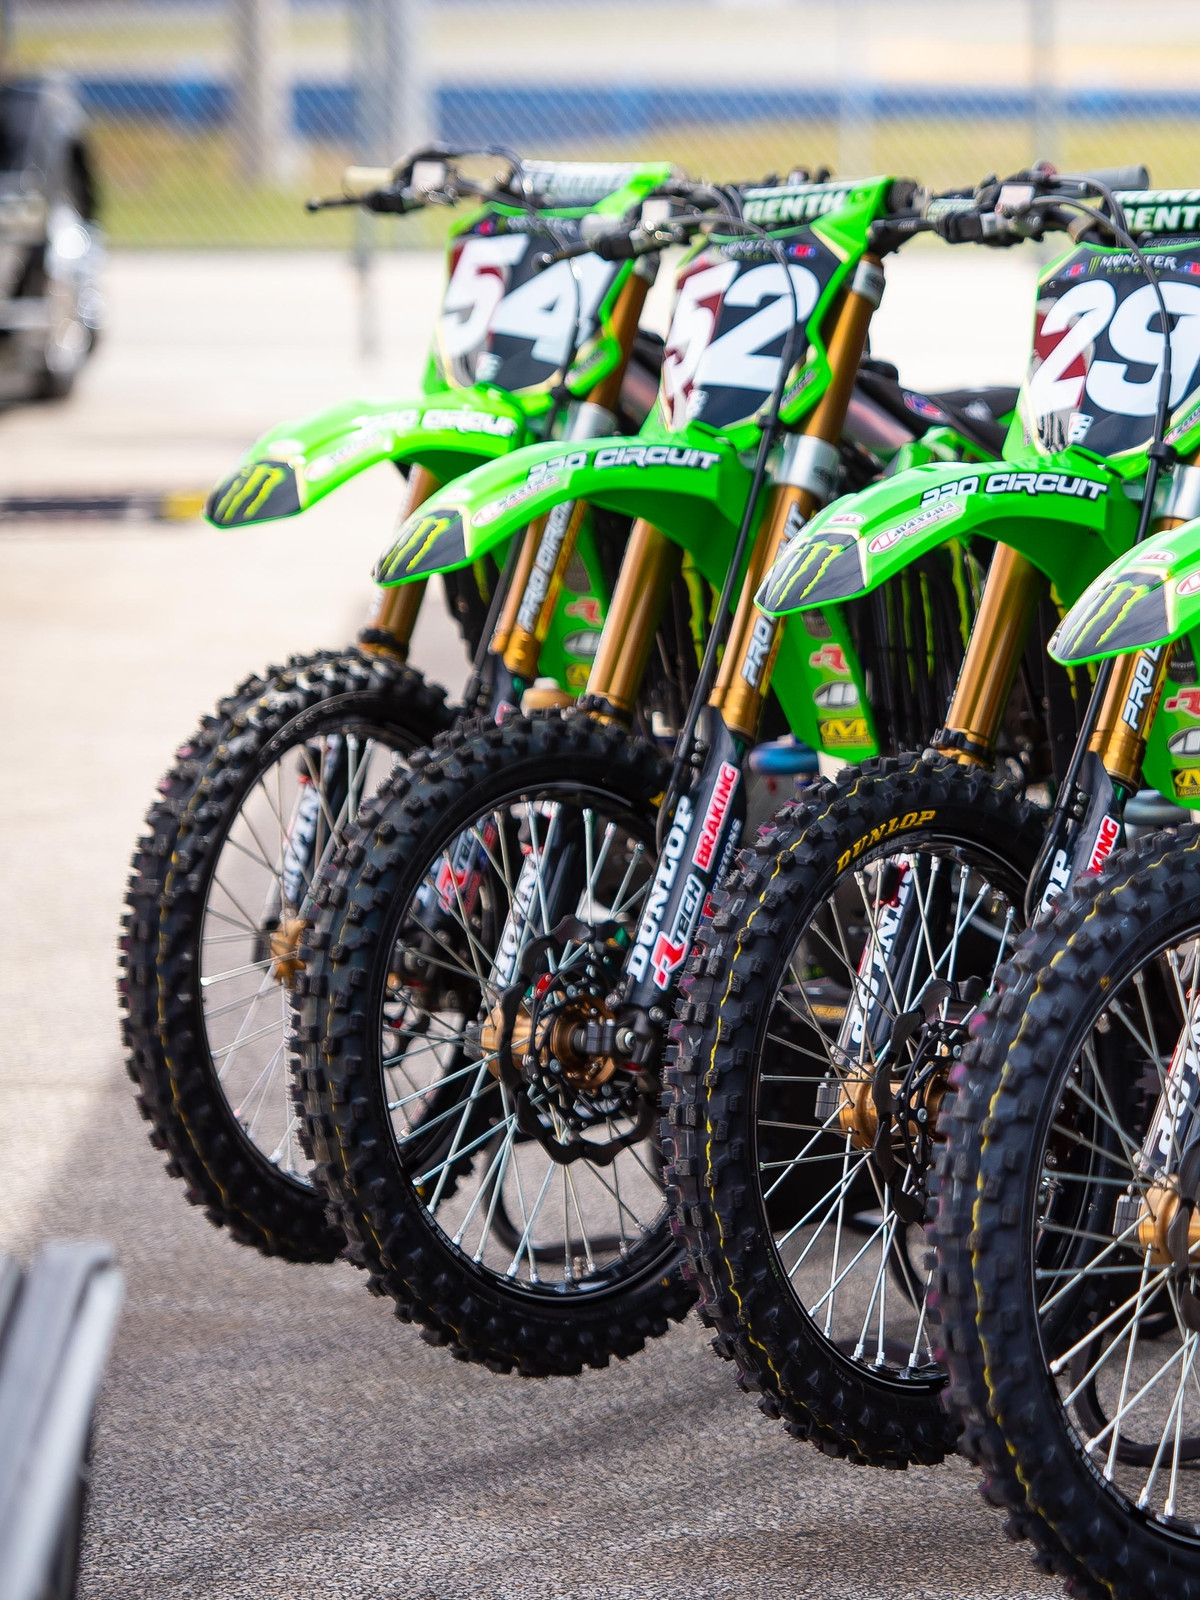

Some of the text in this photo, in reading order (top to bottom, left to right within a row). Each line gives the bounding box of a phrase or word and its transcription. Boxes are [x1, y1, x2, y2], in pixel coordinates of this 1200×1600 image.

[742, 192, 850, 226] RENTH
[440, 233, 615, 366] 54
[663, 258, 819, 397] 52
[594, 445, 722, 470] CIRCUIT
[985, 472, 1107, 500] CIRCUIT
[1121, 660, 1157, 731] PRO
[692, 761, 741, 874] BRAKING
[835, 810, 936, 876] DUNLOP
[1087, 815, 1121, 873] KING
[627, 795, 694, 983] DUNLOP
